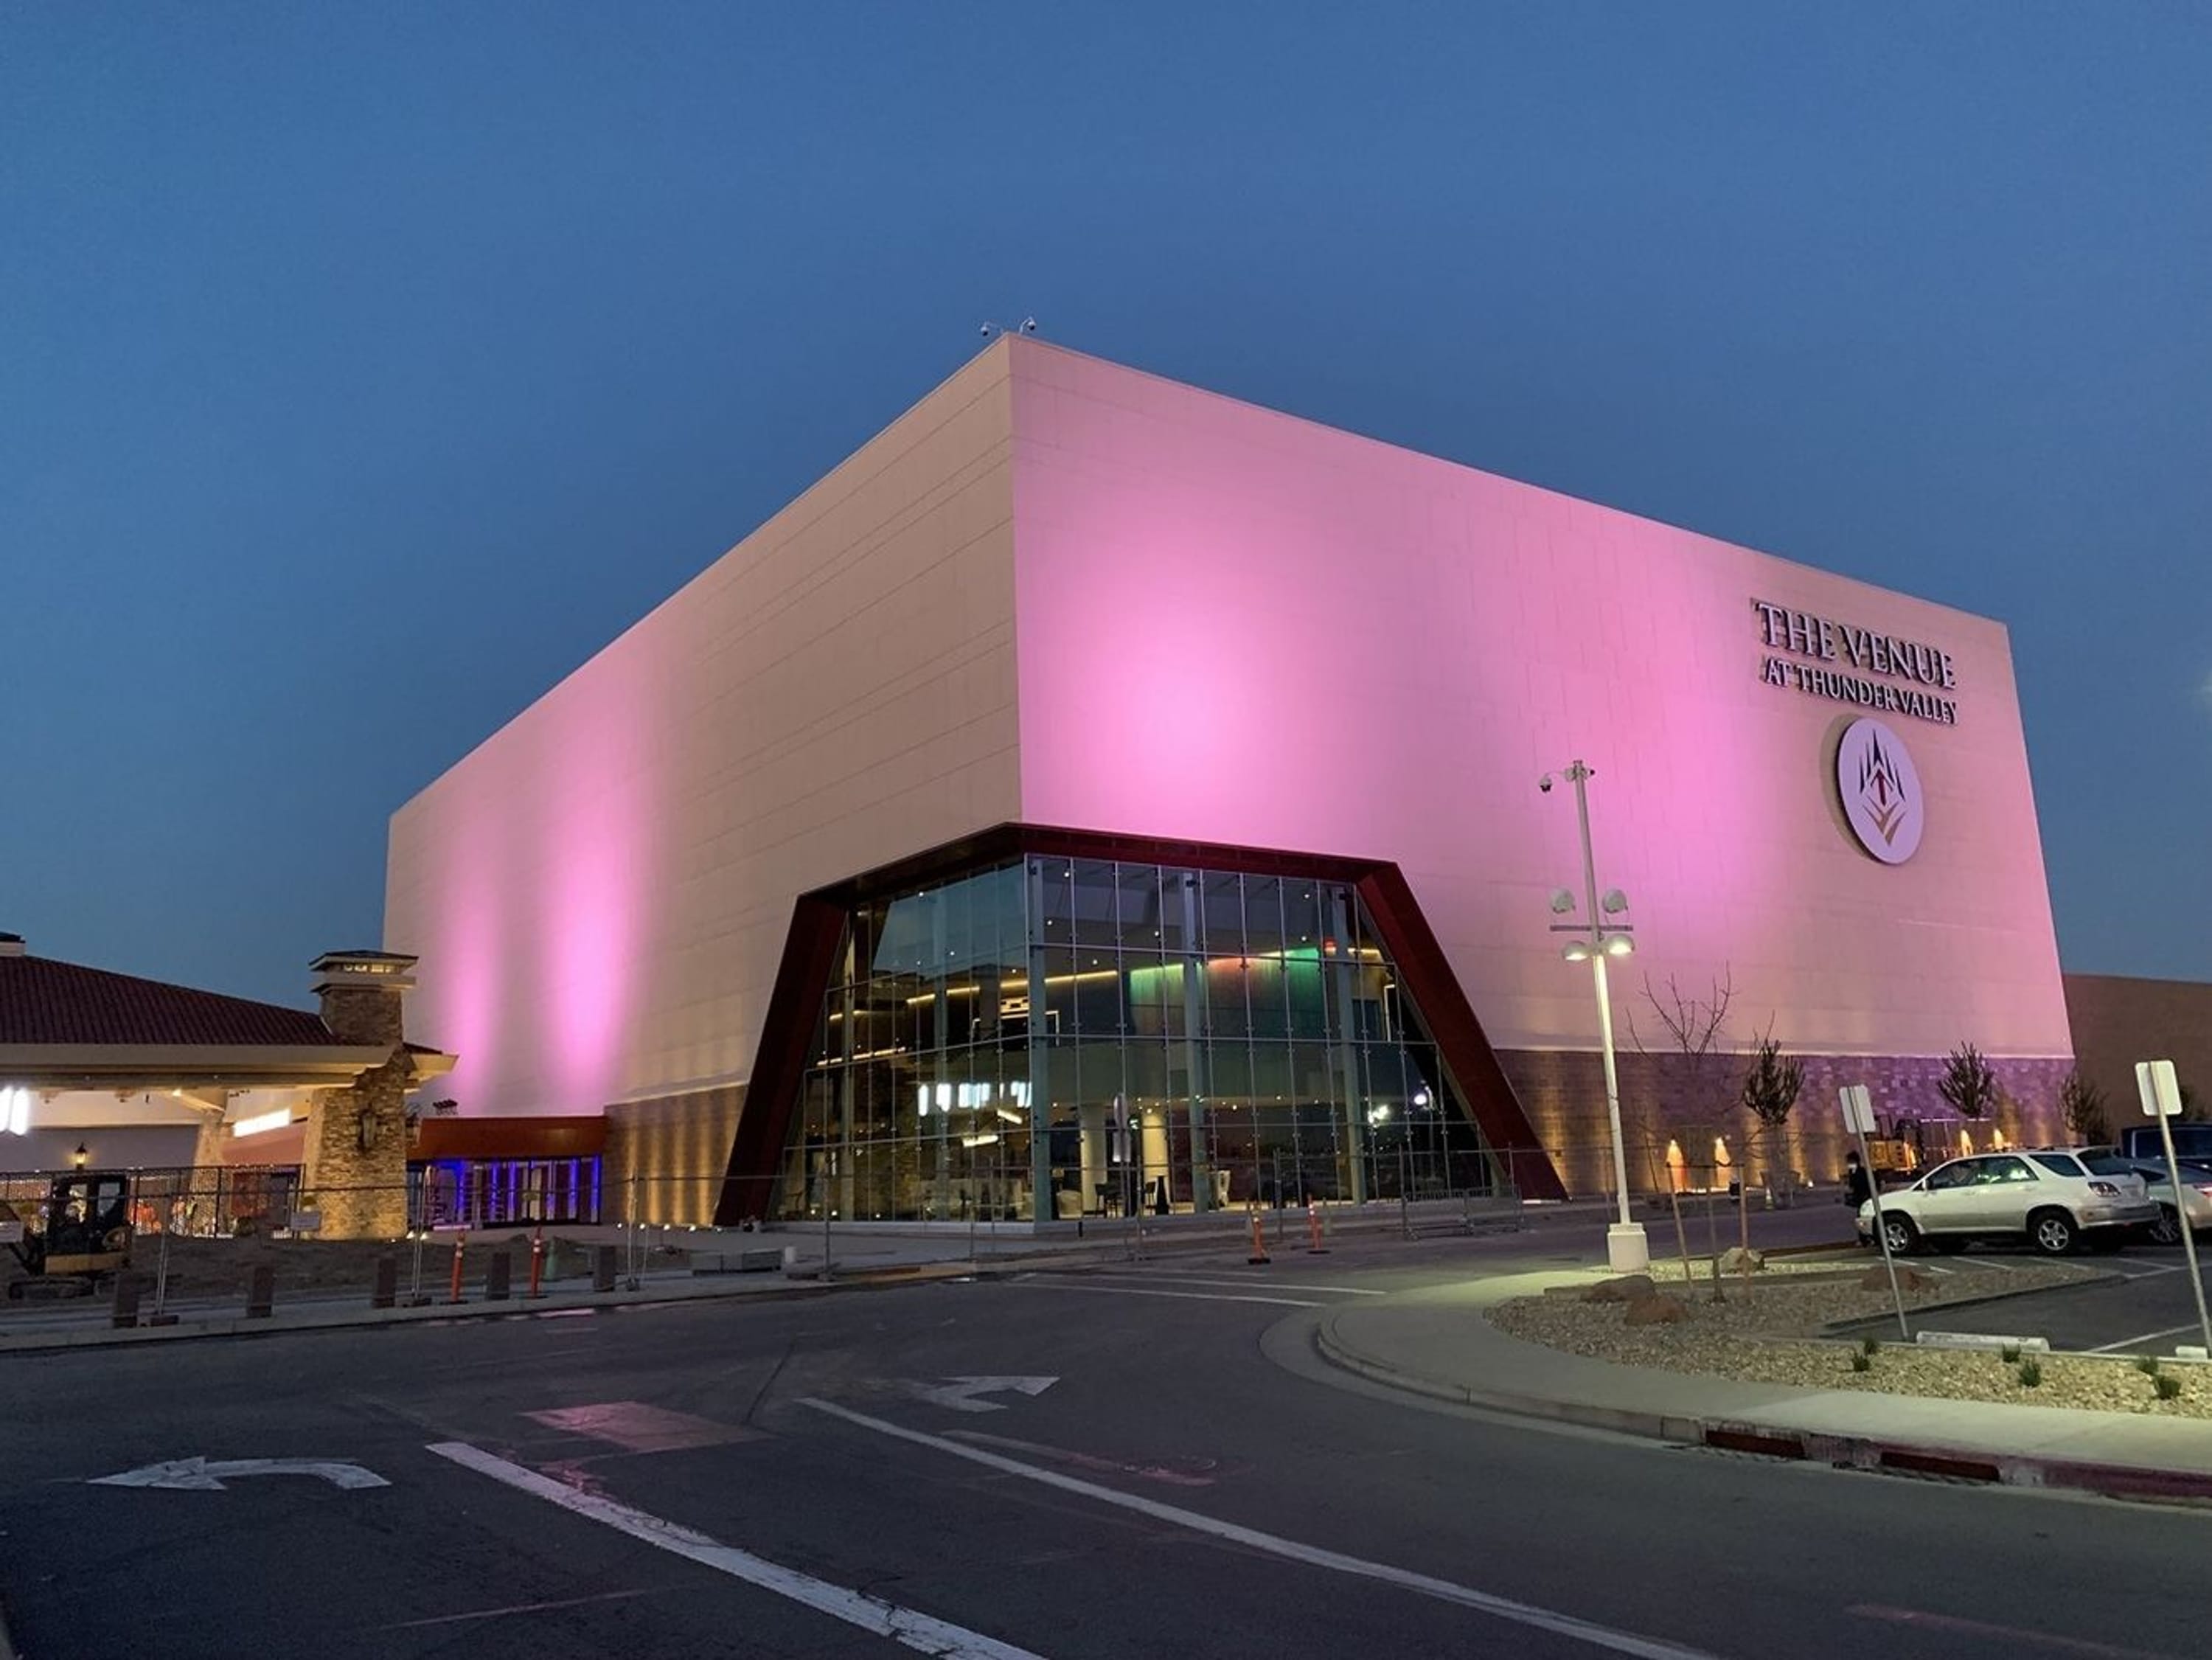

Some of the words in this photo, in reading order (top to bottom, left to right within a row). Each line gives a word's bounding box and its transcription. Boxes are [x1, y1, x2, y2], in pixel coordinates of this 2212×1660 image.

[1756, 602, 1835, 660] THE
[1840, 625, 1956, 689] VENUE
[1764, 656, 1790, 687] AT
[1795, 665, 1899, 710] THUNDER
[1898, 689, 1958, 725] VALLEY
